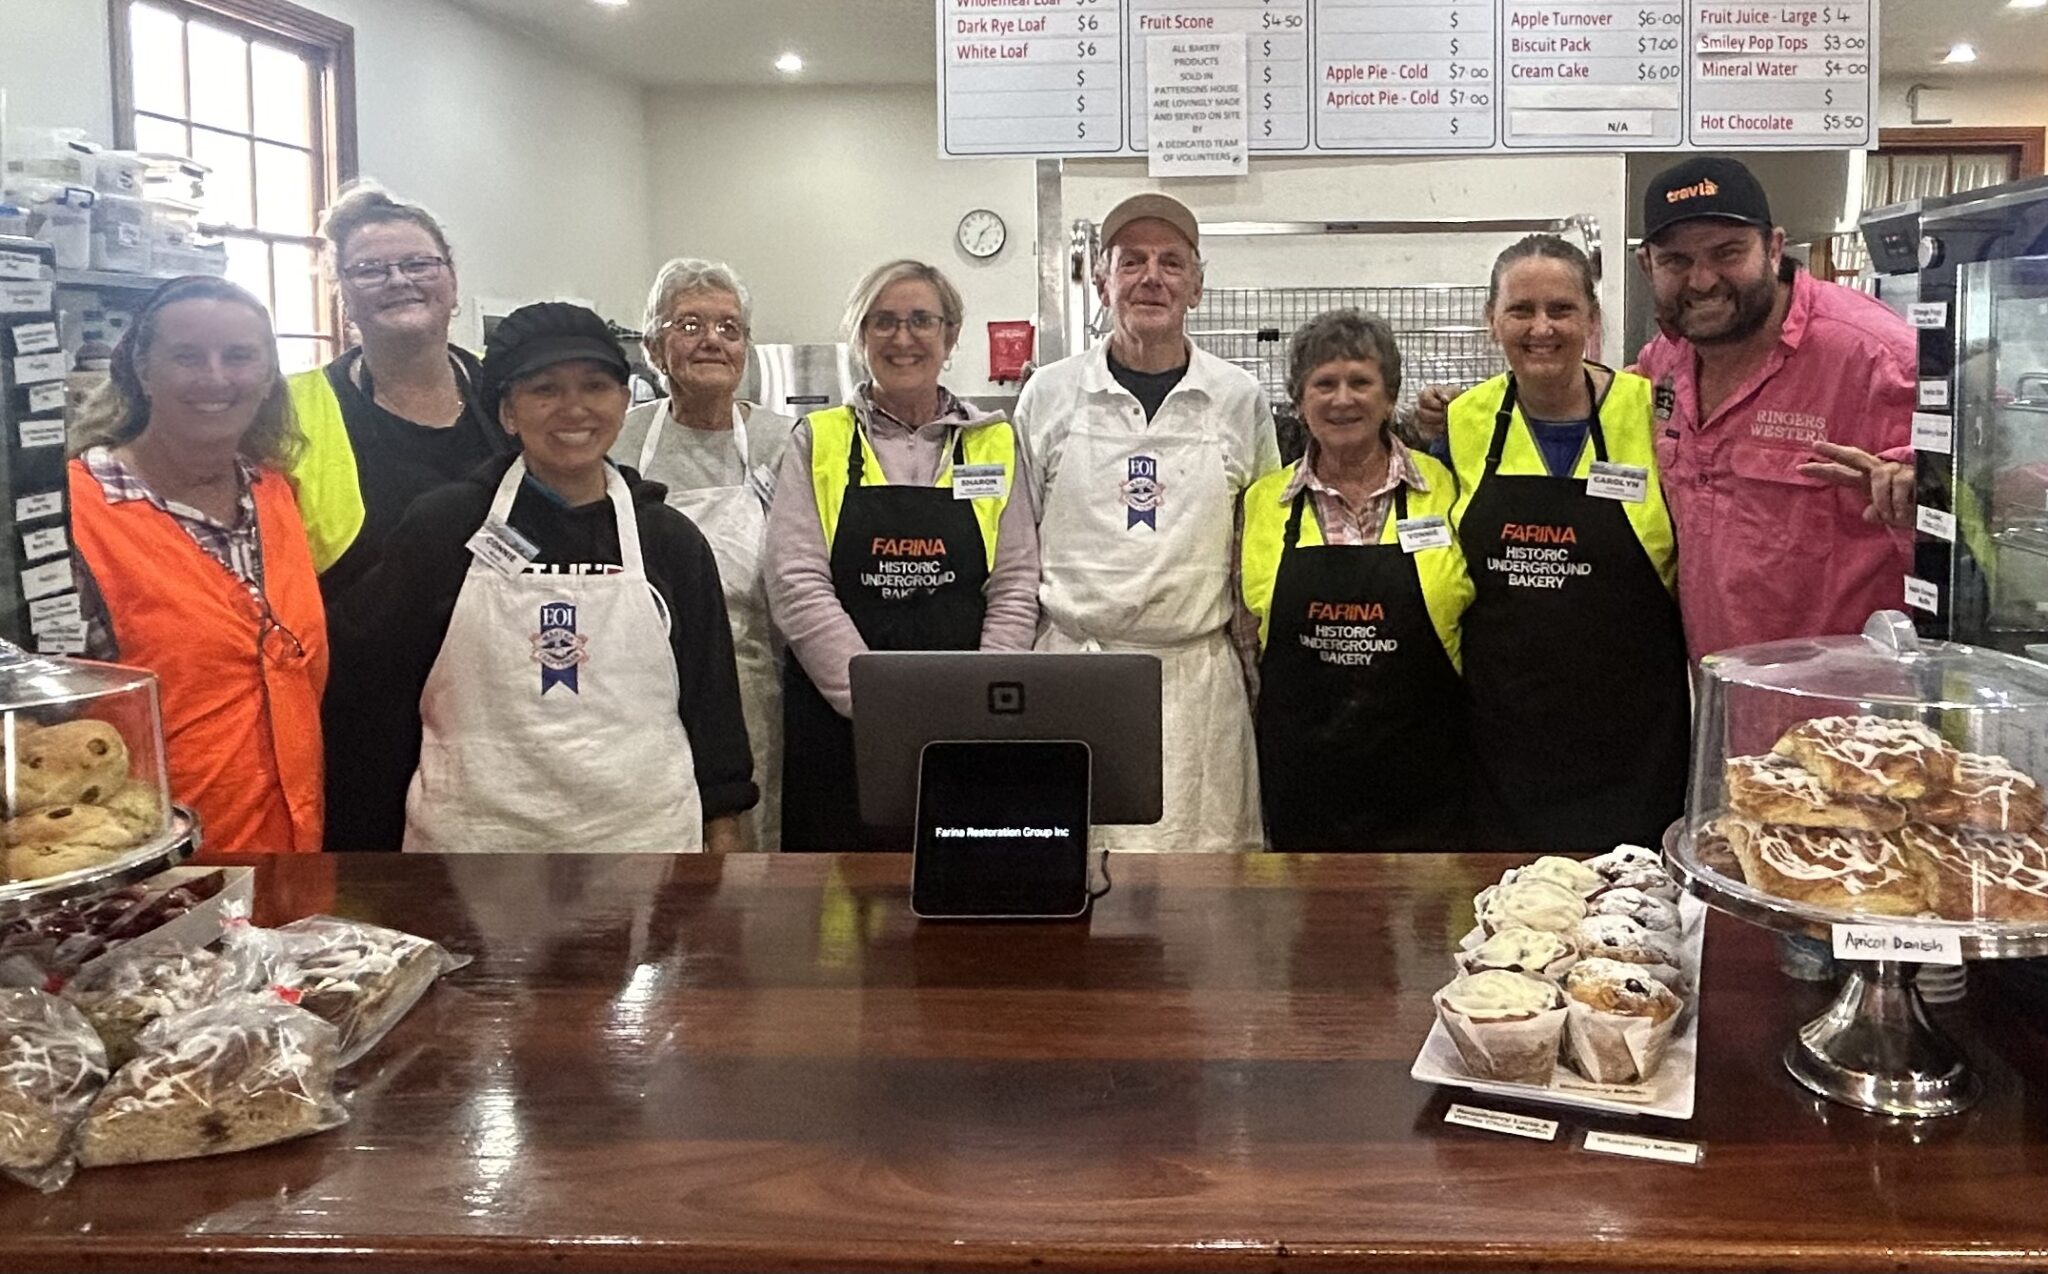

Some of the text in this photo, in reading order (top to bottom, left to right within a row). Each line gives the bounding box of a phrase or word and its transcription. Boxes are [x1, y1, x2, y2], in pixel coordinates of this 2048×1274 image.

[1140, 14, 1171, 30] Fruit
[1175, 15, 1214, 29] Scone
[1511, 11, 1549, 29] Apple
[1552, 12, 1613, 26] Turnover
[1701, 9, 1732, 24] Fruit
[1736, 9, 1769, 24] Juice
[1782, 9, 1817, 26] Large
[957, 17, 988, 33] Dark
[991, 18, 1014, 36] Rye
[1018, 16, 1046, 32] Loaf
[957, 44, 997, 60] White
[1001, 42, 1028, 58] Loaf
[1512, 37, 1557, 52] Biscuit
[1560, 36, 1591, 51] Pack
[1701, 35, 1745, 52] Smiley
[1749, 36, 1773, 51] Pop
[1777, 35, 1808, 51] Tops
[1174, 57, 1219, 66] PRODUCTS
[1702, 62, 1752, 76] Mineral
[1757, 62, 1797, 76] Water
[1180, 72, 1202, 80] SOLD
[1326, 65, 1364, 83] Apple
[1368, 65, 1387, 79] Pie
[1400, 64, 1428, 79] Cold
[1512, 64, 1553, 78] Cream
[1558, 62, 1590, 78] Cake
[1210, 84, 1239, 93] HOUSE
[1327, 91, 1375, 109] Apricot
[1378, 91, 1399, 105] Pie
[1410, 90, 1439, 105] Cold
[1154, 113, 1172, 121] AND
[1208, 111, 1222, 120] ON
[1223, 111, 1240, 119] SITE
[1701, 116, 1724, 130] Hot
[1728, 115, 1793, 130] Chocolate
[1608, 123, 1628, 132] N/A
[1163, 153, 1174, 162] OF
[1757, 410, 1826, 429] RINGERS
[1750, 423, 1828, 442] WESTERN
[1593, 476, 1640, 488] CAROLYN
[1501, 523, 1577, 544] FARINA
[871, 537, 947, 556] FARINA
[1506, 546, 1568, 561] HISTORIC
[879, 560, 941, 574] HISTORIC
[1487, 558, 1592, 575] UNDERGROUND
[1508, 574, 1566, 589] BAKERY
[882, 587, 936, 599] BAKY
[1308, 602, 1384, 621] FARINA
[1315, 625, 1377, 638] HISTORIC
[1300, 634, 1398, 651] UNDERGROUND
[1320, 651, 1373, 665] BAKERY
[935, 826, 1070, 838] Farina Restoration Group Inc
[1845, 931, 1943, 952] Apricot Danish
